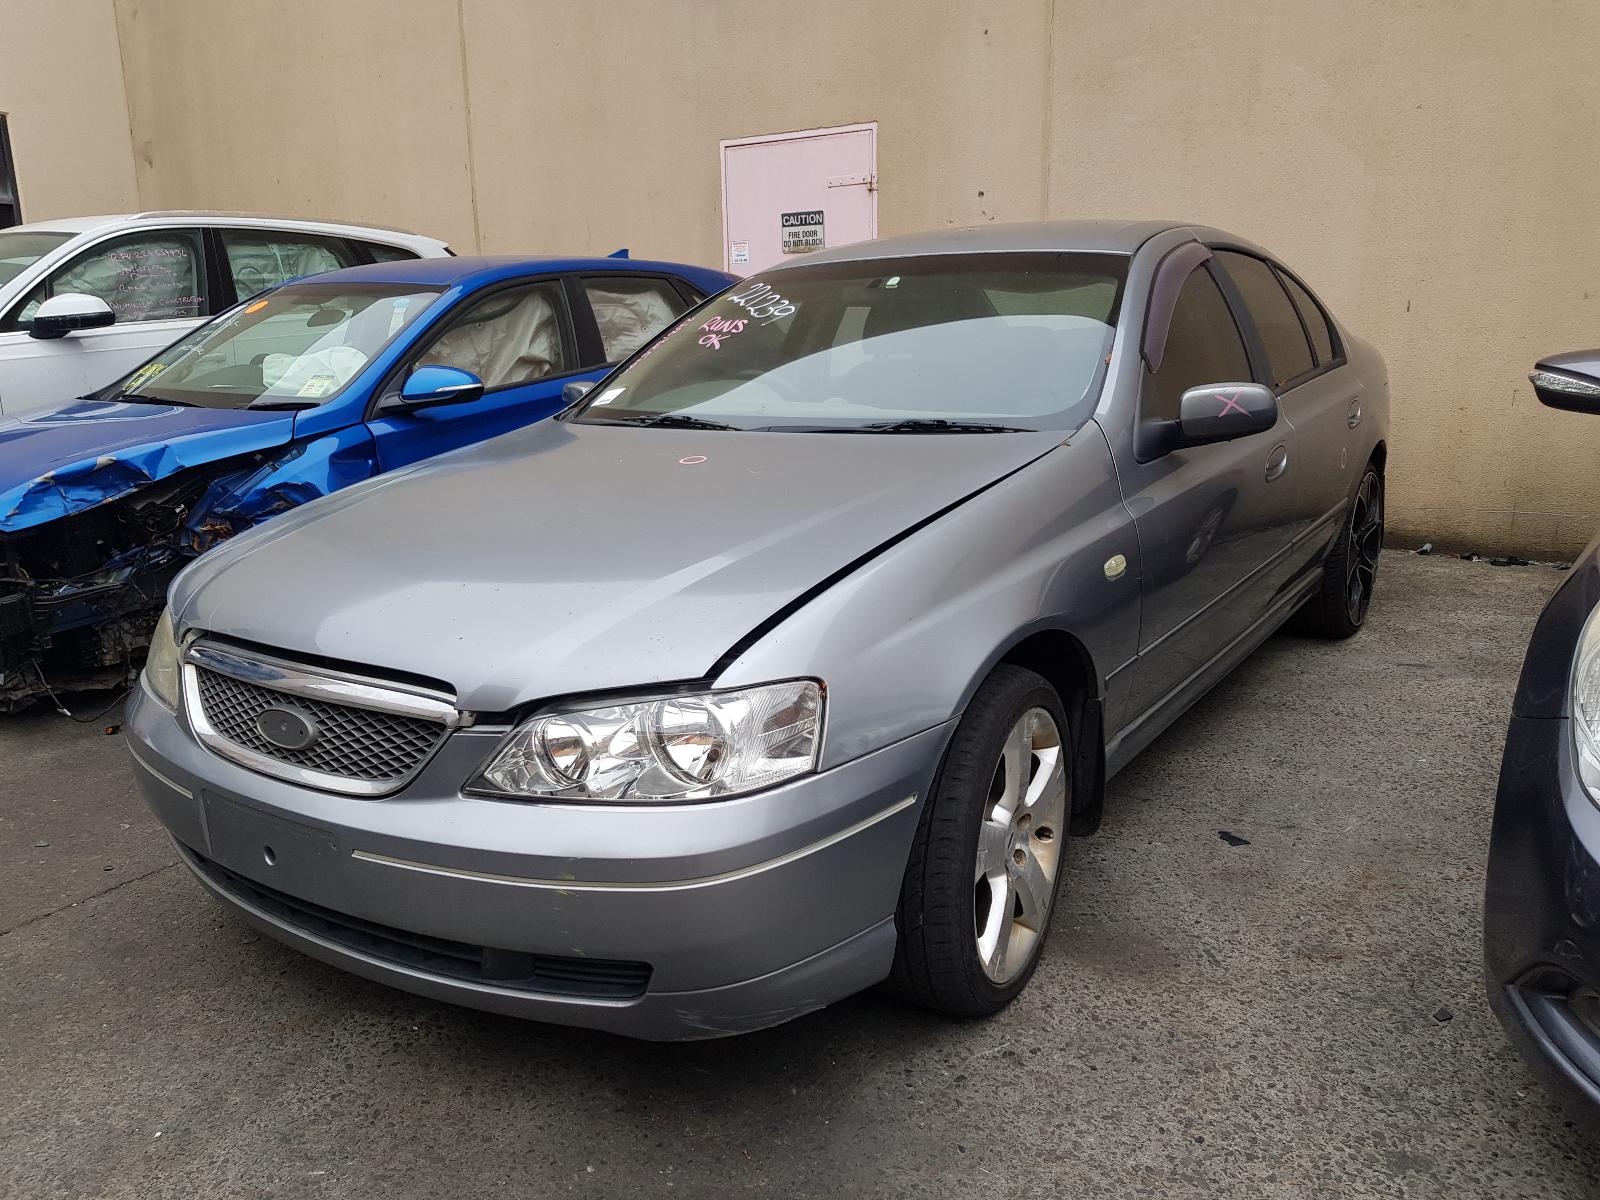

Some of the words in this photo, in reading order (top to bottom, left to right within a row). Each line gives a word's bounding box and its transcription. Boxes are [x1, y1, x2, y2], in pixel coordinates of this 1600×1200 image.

[783, 213, 823, 226] CAUTION
[788, 231, 801, 239] FIRE
[802, 230, 818, 238] DOOR
[783, 240, 792, 248] DO
[793, 239, 803, 247] NOT
[804, 238, 823, 246] BLOCK
[698, 315, 749, 333] RUNS
[698, 333, 732, 351] OK
